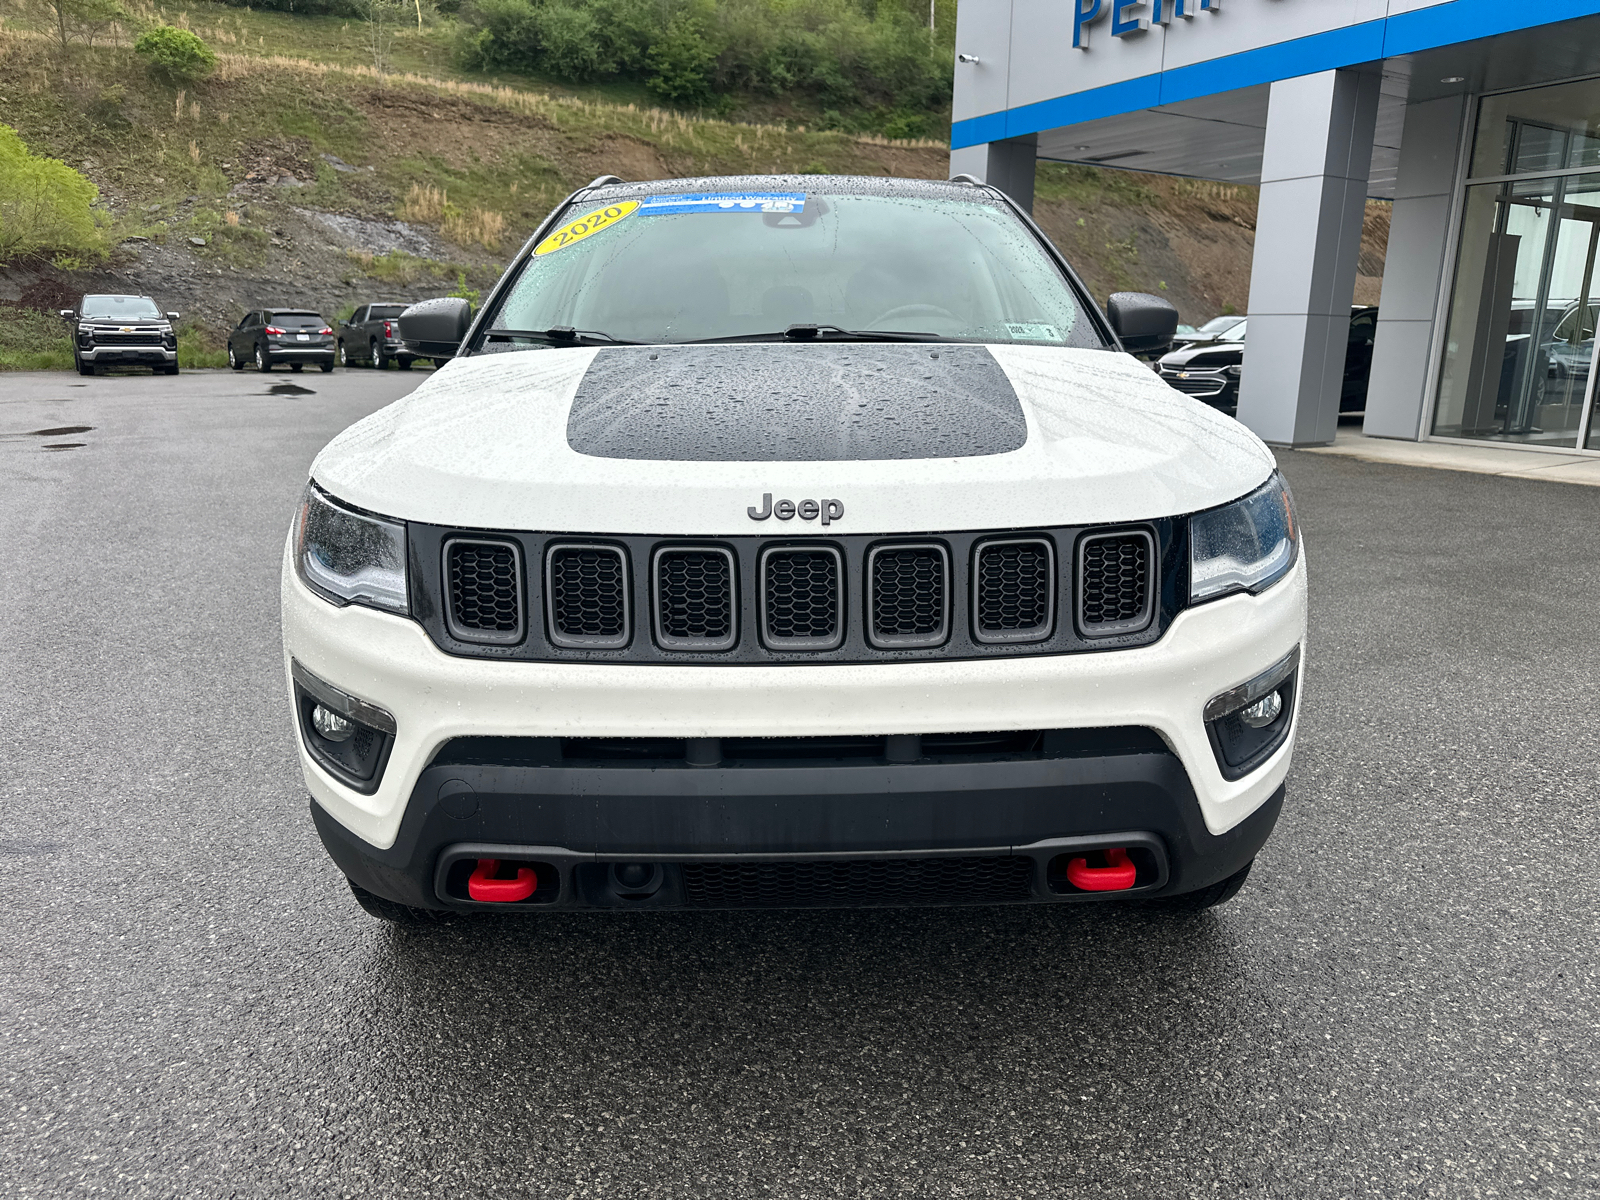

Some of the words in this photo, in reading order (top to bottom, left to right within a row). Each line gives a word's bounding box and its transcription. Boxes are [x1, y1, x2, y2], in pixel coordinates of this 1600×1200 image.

[745, 194, 797, 202] Warranty
[553, 207, 622, 247] 2020
[747, 493, 844, 525] Jeep
